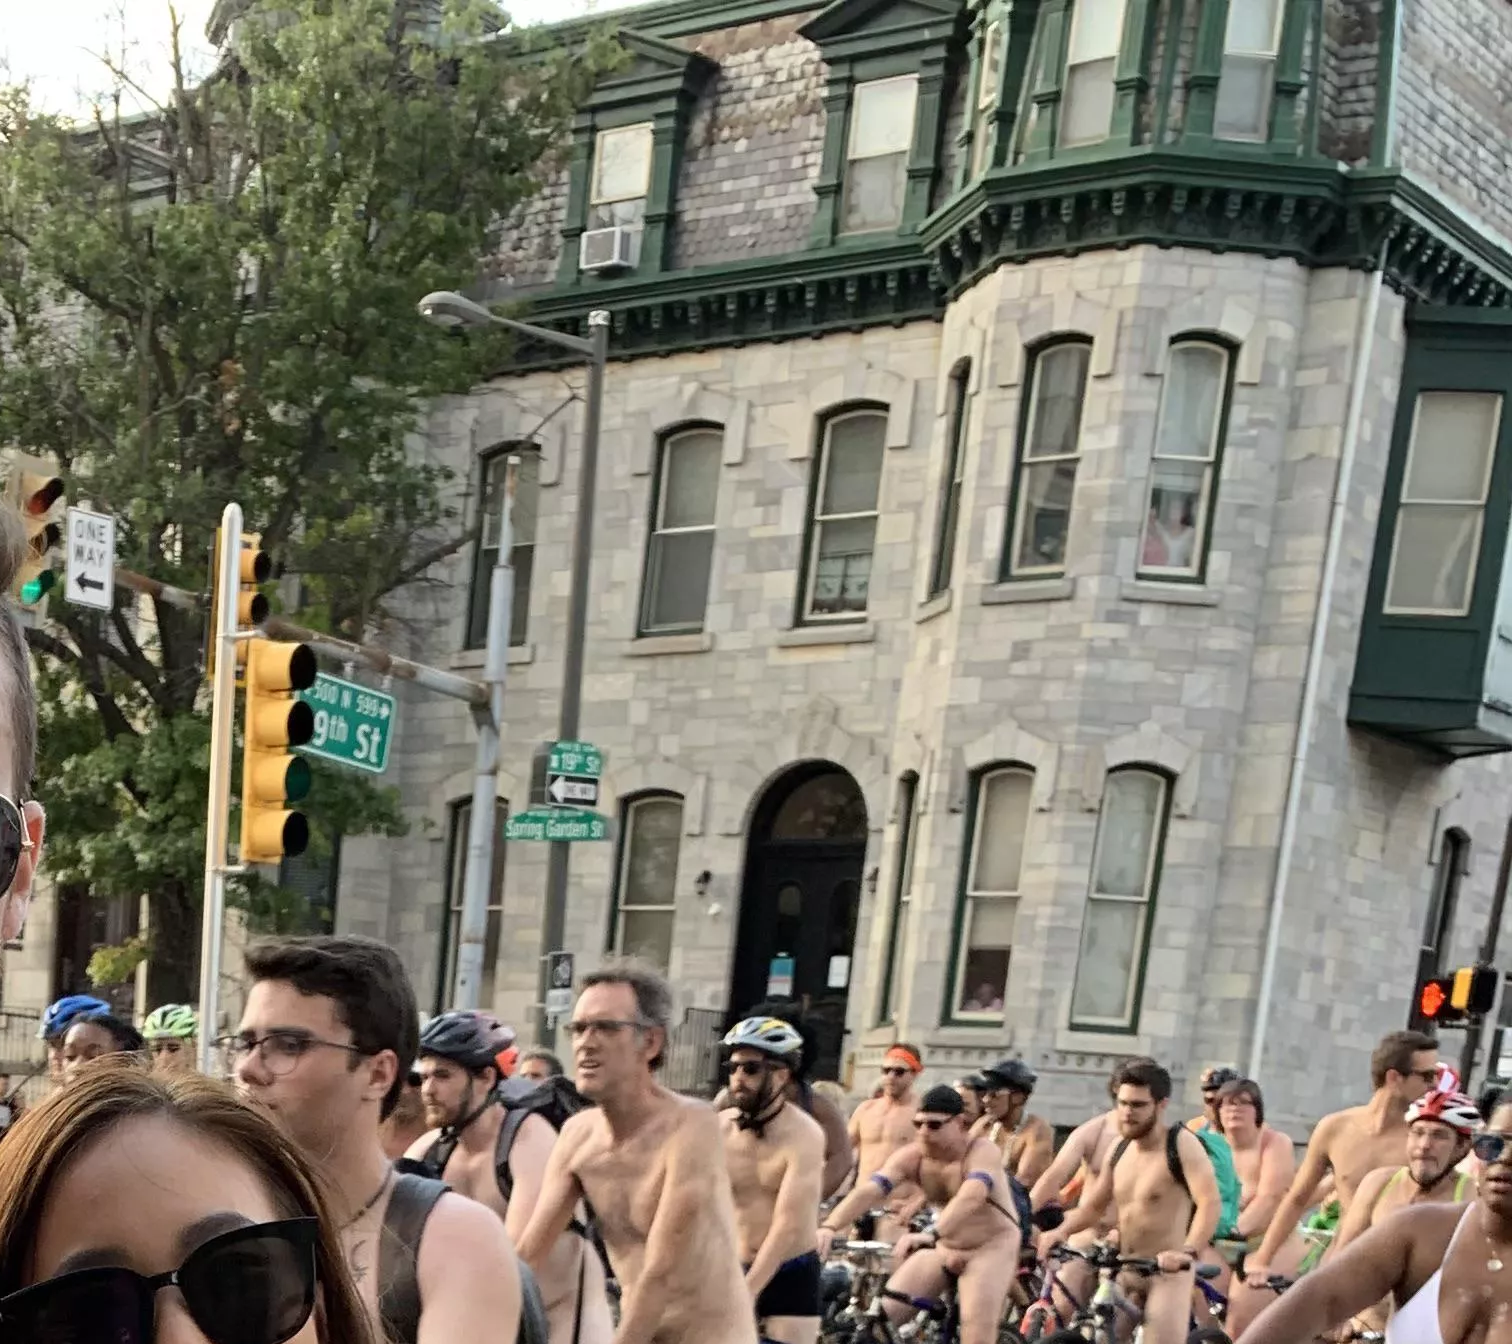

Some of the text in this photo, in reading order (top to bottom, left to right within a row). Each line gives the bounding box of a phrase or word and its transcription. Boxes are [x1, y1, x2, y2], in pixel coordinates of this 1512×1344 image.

[75, 519, 107, 544] ONE
[73, 545, 107, 568] WAY
[312, 710, 382, 763] 9th St
[561, 752, 584, 771] 19th
[505, 819, 604, 840] Spring Garden St
